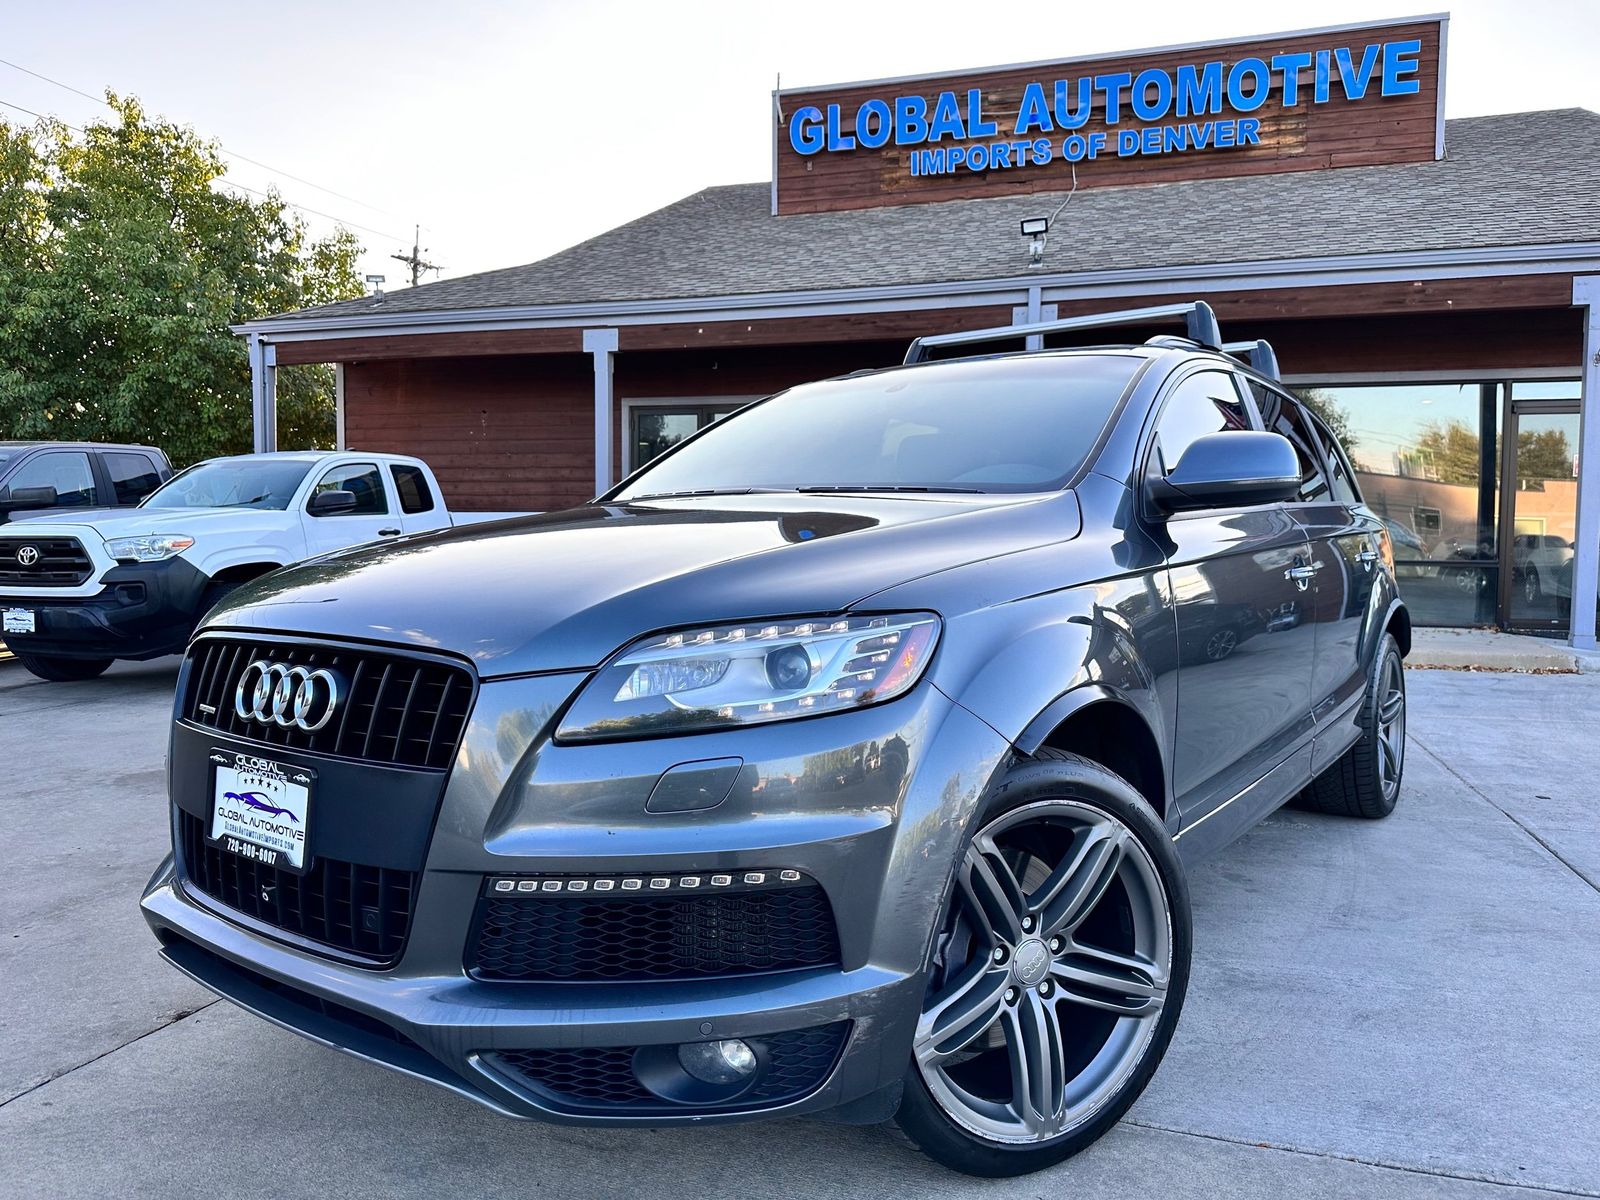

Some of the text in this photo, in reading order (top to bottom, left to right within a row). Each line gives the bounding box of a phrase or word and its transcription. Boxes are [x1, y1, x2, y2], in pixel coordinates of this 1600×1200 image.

[789, 39, 1422, 155] GLOBAL AUTOMOTIVE
[910, 117, 1262, 177] IMPORTS OF DENVER
[233, 764, 288, 782] AUTOMOTIVE
[235, 754, 284, 775] GLOBAL
[217, 806, 305, 841] GLOBAL AUTOMOTIVE
